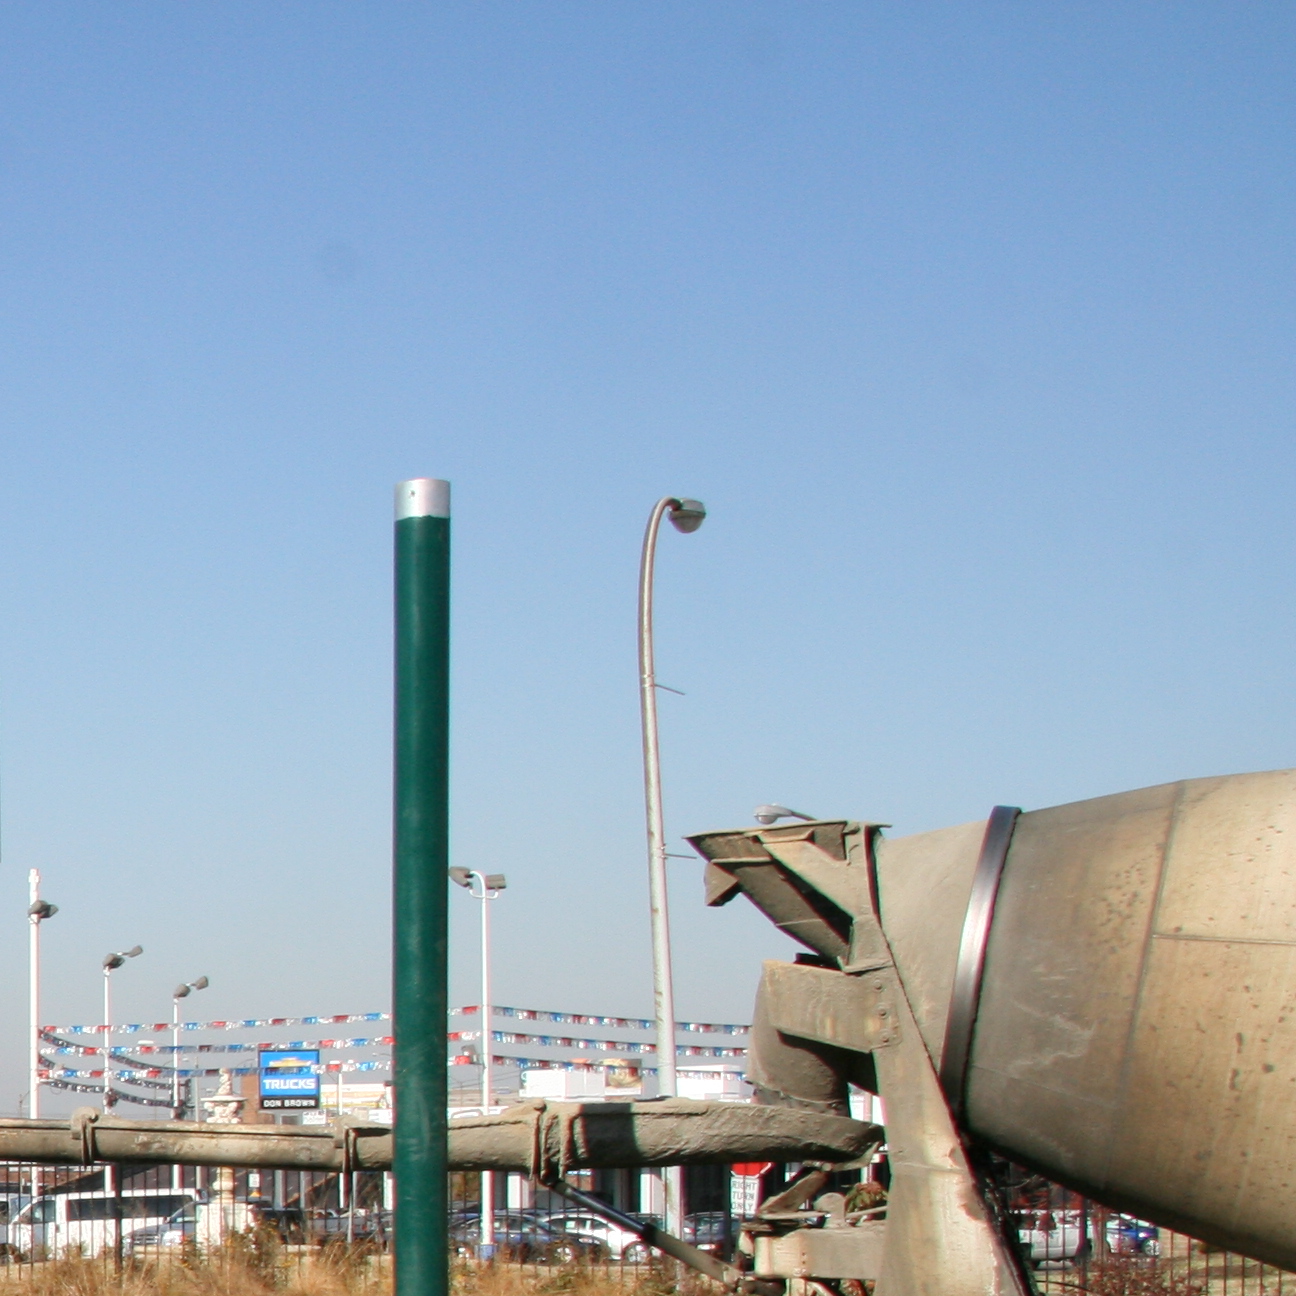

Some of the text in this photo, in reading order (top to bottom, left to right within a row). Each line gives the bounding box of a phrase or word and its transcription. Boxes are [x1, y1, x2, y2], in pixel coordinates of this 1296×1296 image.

[262, 1078, 316, 1090] TRUCKS
[263, 1099, 316, 1107] DON BROWN
